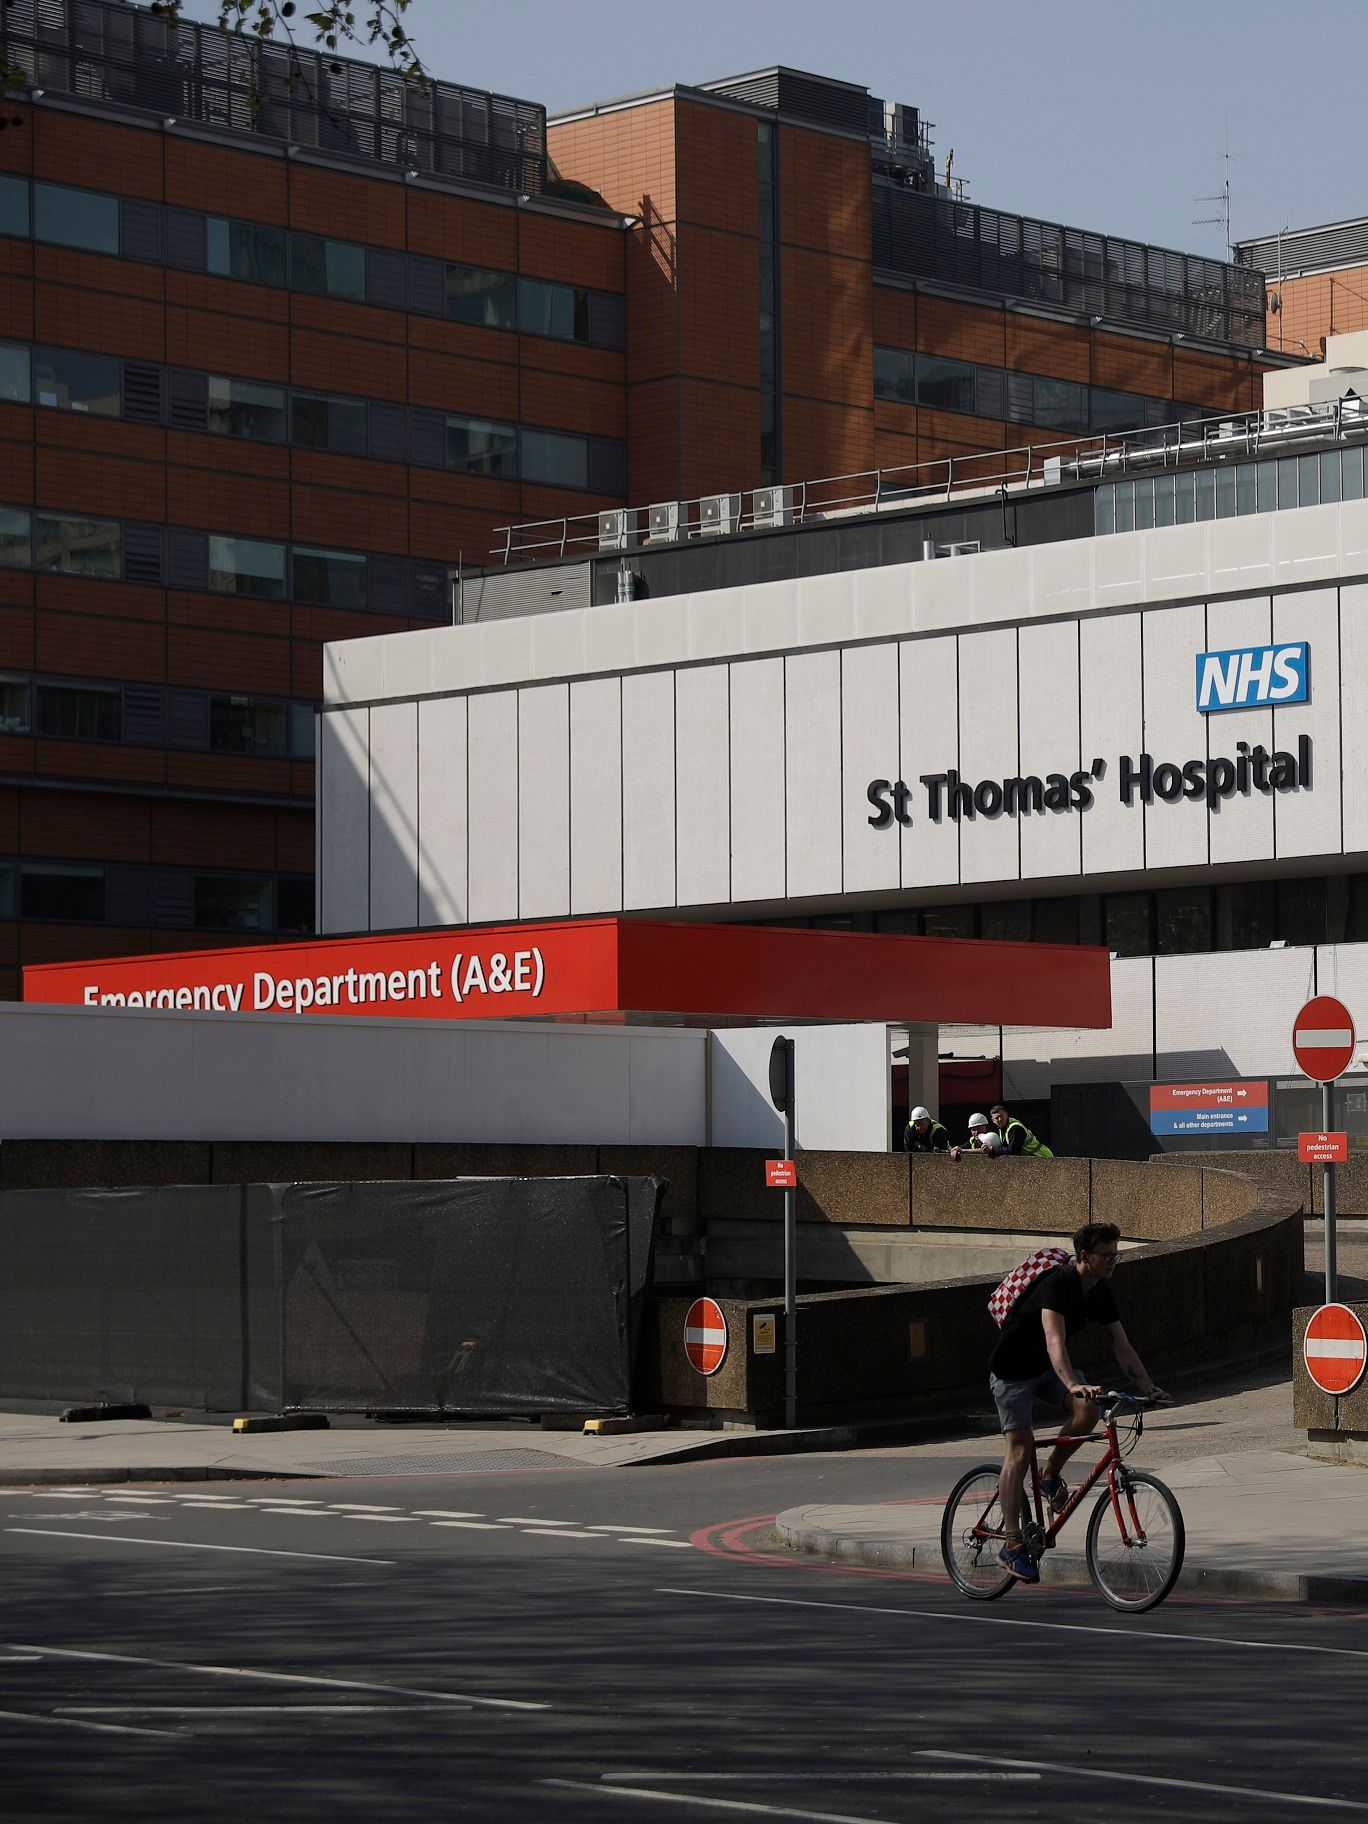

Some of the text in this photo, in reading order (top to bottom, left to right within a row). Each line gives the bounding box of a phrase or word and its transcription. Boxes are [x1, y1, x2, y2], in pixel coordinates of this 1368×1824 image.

[1198, 646, 1302, 707] NHS
[867, 734, 1311, 827] St Thomas' Hospital
[253, 961, 442, 1014] Department
[450, 947, 544, 1003] (A&E)
[1172, 1087, 1233, 1098] Emergency Department
[1200, 1120, 1234, 1129] departments
[1318, 1134, 1328, 1142] No
[1306, 1143, 1340, 1152] pedestrian
[1313, 1152, 1333, 1160] access
[770, 1170, 792, 1178] pedestrian
